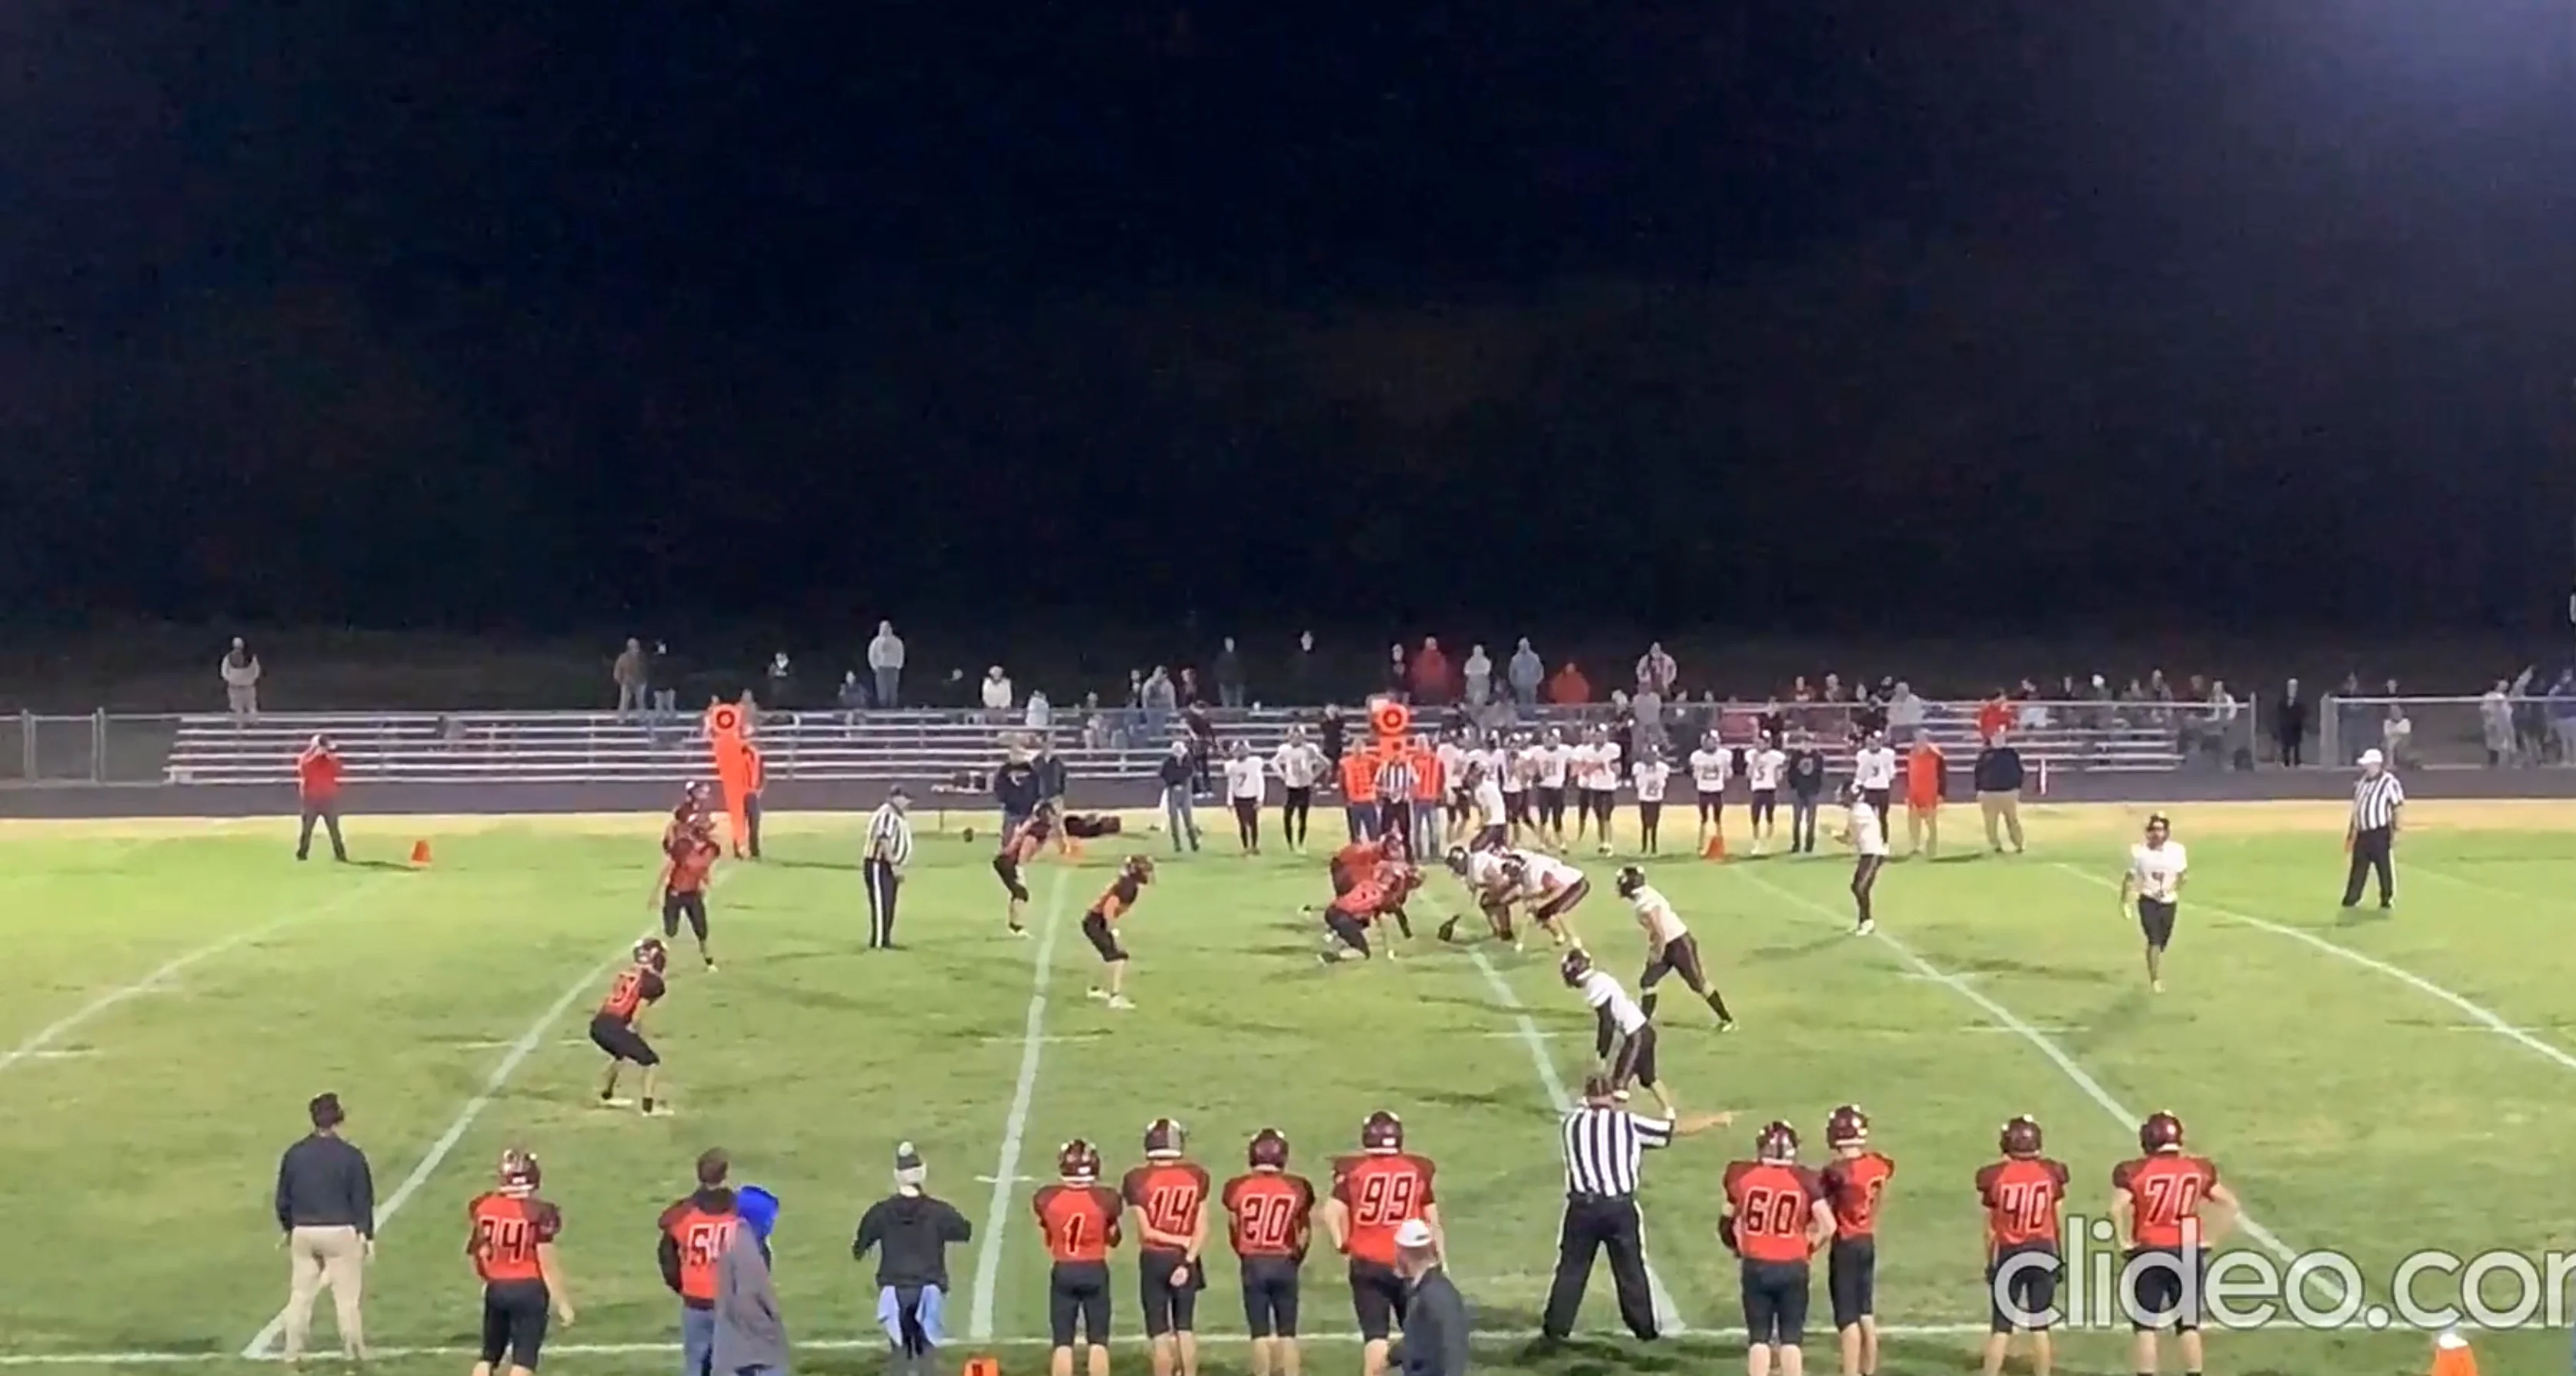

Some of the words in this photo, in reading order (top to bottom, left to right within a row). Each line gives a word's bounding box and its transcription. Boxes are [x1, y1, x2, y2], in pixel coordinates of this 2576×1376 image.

[1149, 1185, 1197, 1233] 14
[1242, 1192, 1296, 1247] 20
[1356, 1172, 1416, 1225] 99
[1743, 1188, 1801, 1237] 60
[2000, 1183, 2051, 1233] 40
[2144, 1173, 2202, 1226] 70
[1063, 1212, 1085, 1256] 1
